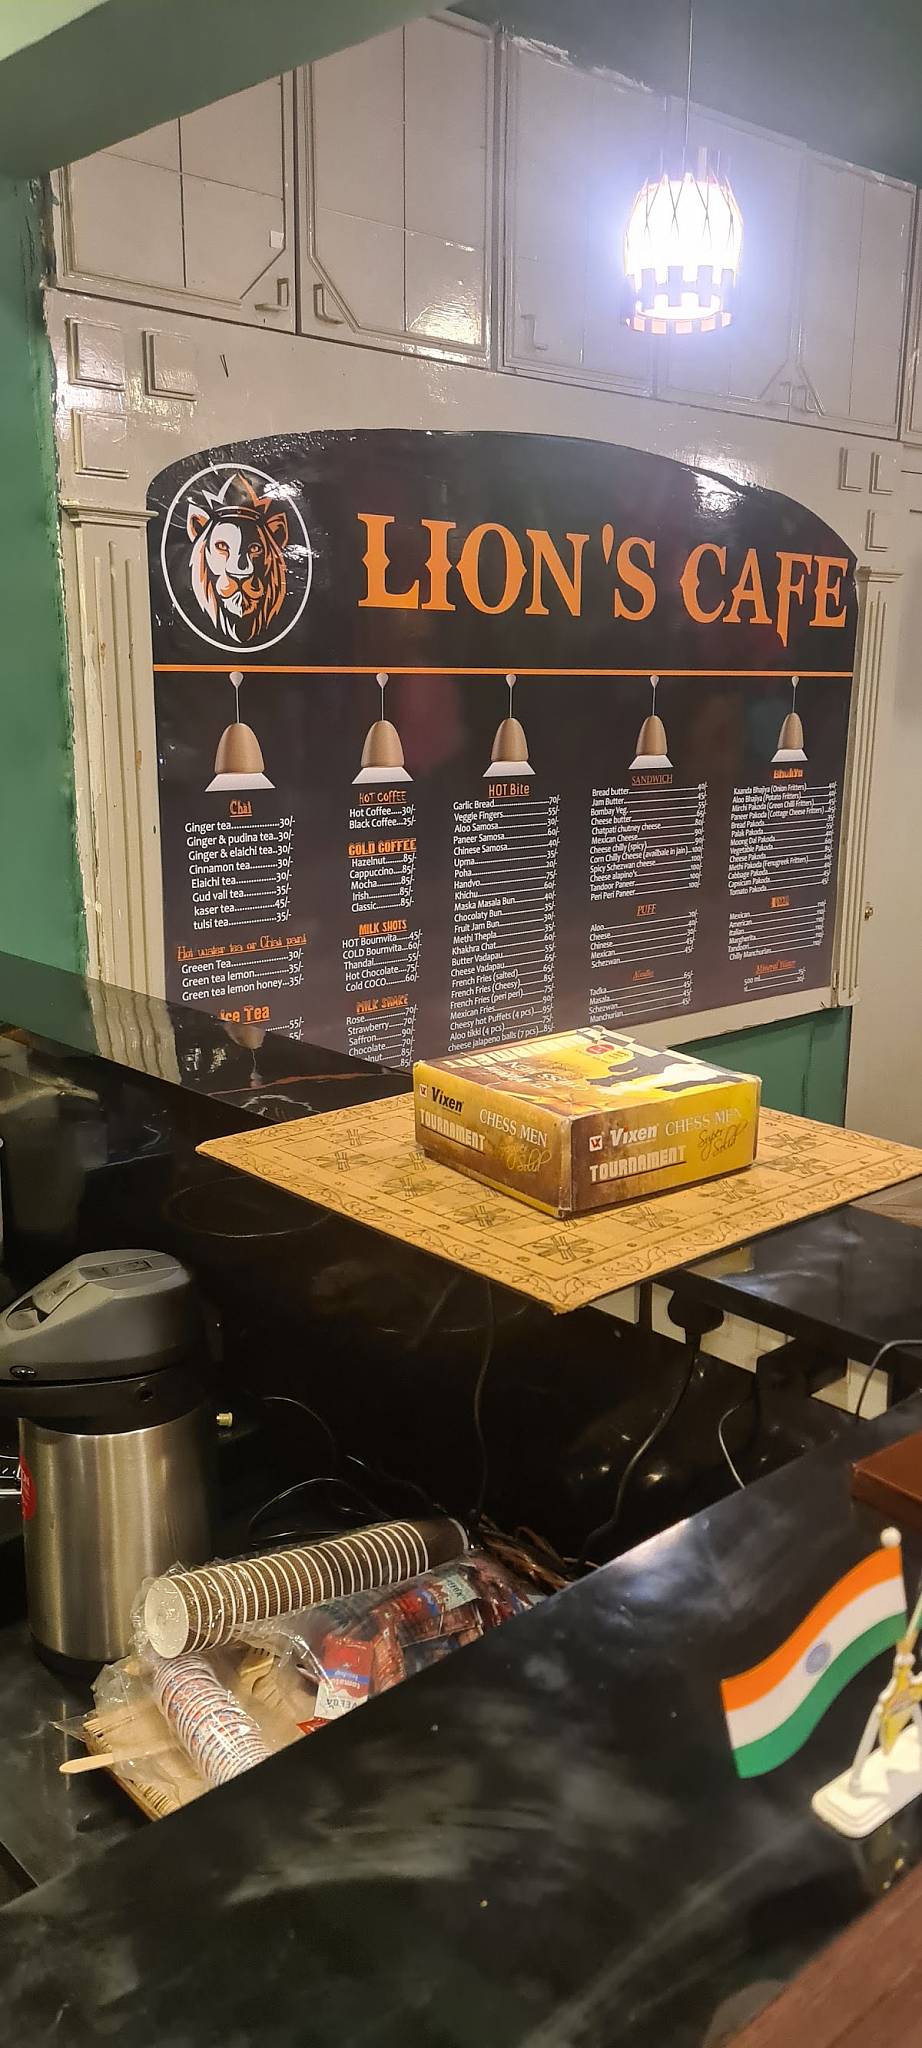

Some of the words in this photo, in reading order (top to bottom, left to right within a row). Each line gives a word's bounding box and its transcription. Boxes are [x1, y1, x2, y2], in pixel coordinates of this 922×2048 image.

[357, 512, 658, 622] LION'S
[681, 543, 849, 647] CAFE
[632, 775, 672, 784] SANDWICH
[489, 784, 507, 797] HOT
[510, 784, 529, 795] Bite
[592, 788, 610, 796] Bread
[453, 801, 473, 810] Garlic
[475, 799, 494, 808] Bread
[350, 809, 364, 817] Hot
[366, 806, 391, 816] Coffee
[454, 812, 477, 823] Veggie
[479, 811, 503, 821] Fingers
[185, 823, 215, 834] Ginger
[217, 822, 231, 830] tea
[350, 819, 370, 829] Black
[372, 817, 397, 827] Coffee
[472, 823, 498, 831] Samosa
[187, 837, 217, 848] Ginger
[219, 835, 226, 844] &
[229, 833, 257, 846] pudina
[260, 832, 274, 840] tea
[454, 836, 477, 844] Paneer
[479, 834, 504, 842] Samosa
[349, 842, 375, 855] COLD
[378, 838, 416, 852] COFFEE
[454, 847, 480, 855] Chinese
[482, 844, 507, 853] Samosa
[189, 851, 218, 862] Ginger
[221, 849, 228, 858] &
[230, 846, 257, 857] elaichi
[259, 846, 273, 854] tea
[352, 857, 386, 867] Hazelnut
[454, 858, 475, 868] Upma
[189, 864, 234, 874] Cinnamon
[350, 867, 393, 879] Cappuccino
[455, 869, 472, 877] Poha
[192, 877, 219, 888] Elaichi
[222, 877, 236, 885] tea
[351, 880, 377, 890] Mocha
[454, 879, 480, 888] Handvo
[193, 891, 210, 902] Gud
[353, 891, 369, 901] Irish
[455, 890, 478, 900] Khichu
[195, 906, 218, 916] kaser
[220, 905, 234, 913] tea
[352, 902, 376, 912] Classic
[194, 919, 212, 929] tulsi
[214, 919, 228, 927] tea
[360, 923, 379, 935] MILK
[383, 920, 407, 932] SHOTS
[343, 939, 359, 948] HOT
[361, 934, 396, 945] Bournvita
[343, 949, 364, 959] COLD
[367, 944, 401, 955] Bournvita
[182, 963, 213, 973] Greeen
[216, 960, 231, 968] Tea
[344, 958, 374, 970] Thandai
[452, 957, 473, 966] Butter
[183, 978, 209, 987] Green
[212, 974, 225, 983] tea
[228, 970, 254, 981] lemon
[346, 972, 359, 980] Hot
[362, 966, 398, 978] Chocolate
[346, 982, 362, 991] Cold
[365, 978, 386, 988] COCO
[452, 977, 475, 987] French
[477, 975, 492, 983] Fries
[182, 991, 209, 1001] Green
[212, 988, 225, 996] tea
[228, 985, 254, 994] lemon
[257, 979, 282, 990] honey
[244, 1005, 269, 1021] Tea
[347, 1016, 365, 1025] Rose
[348, 1022, 389, 1035] Strawberry
[349, 1035, 376, 1046] Saffron
[349, 1044, 385, 1056] Chocolate
[432, 1087, 463, 1112] Vixen
[480, 1109, 516, 1136] CHESS
[520, 1125, 547, 1147] MEN
[666, 1115, 711, 1136] CHESS
[714, 1109, 741, 1123] MEN
[420, 1109, 485, 1151] TOURNAMENT
[610, 1125, 657, 1146] Vixen
[590, 1146, 686, 1182] TOURNAMENT
